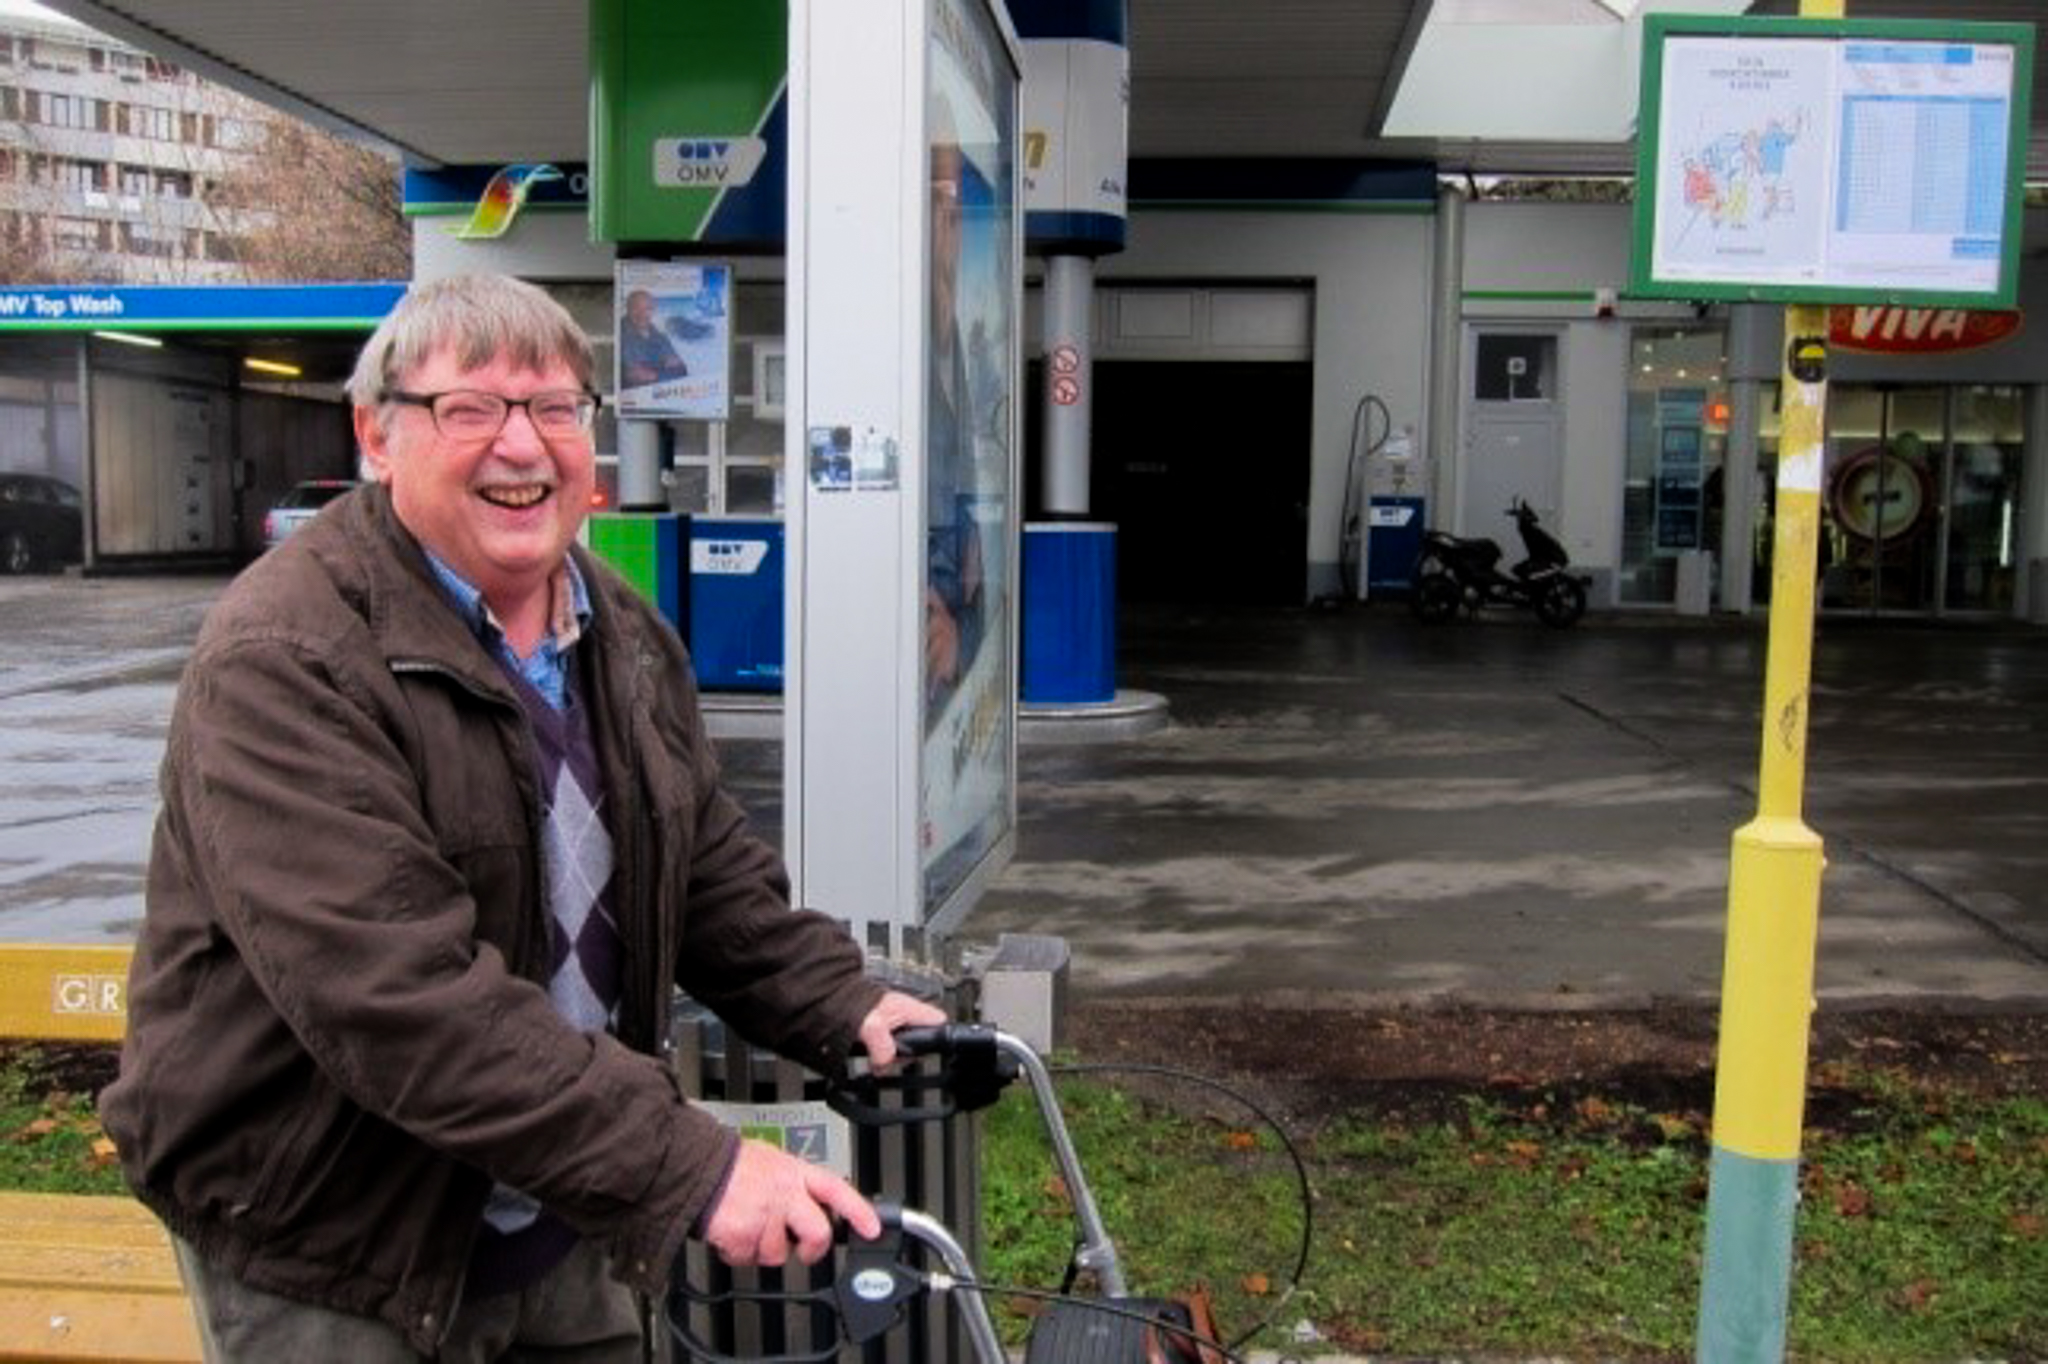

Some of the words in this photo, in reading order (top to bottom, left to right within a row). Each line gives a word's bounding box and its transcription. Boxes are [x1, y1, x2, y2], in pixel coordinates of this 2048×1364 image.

[677, 165, 729, 181] OMV
[31, 293, 66, 317] Top
[69, 292, 124, 315] Wash
[1851, 305, 1968, 341] VIVA
